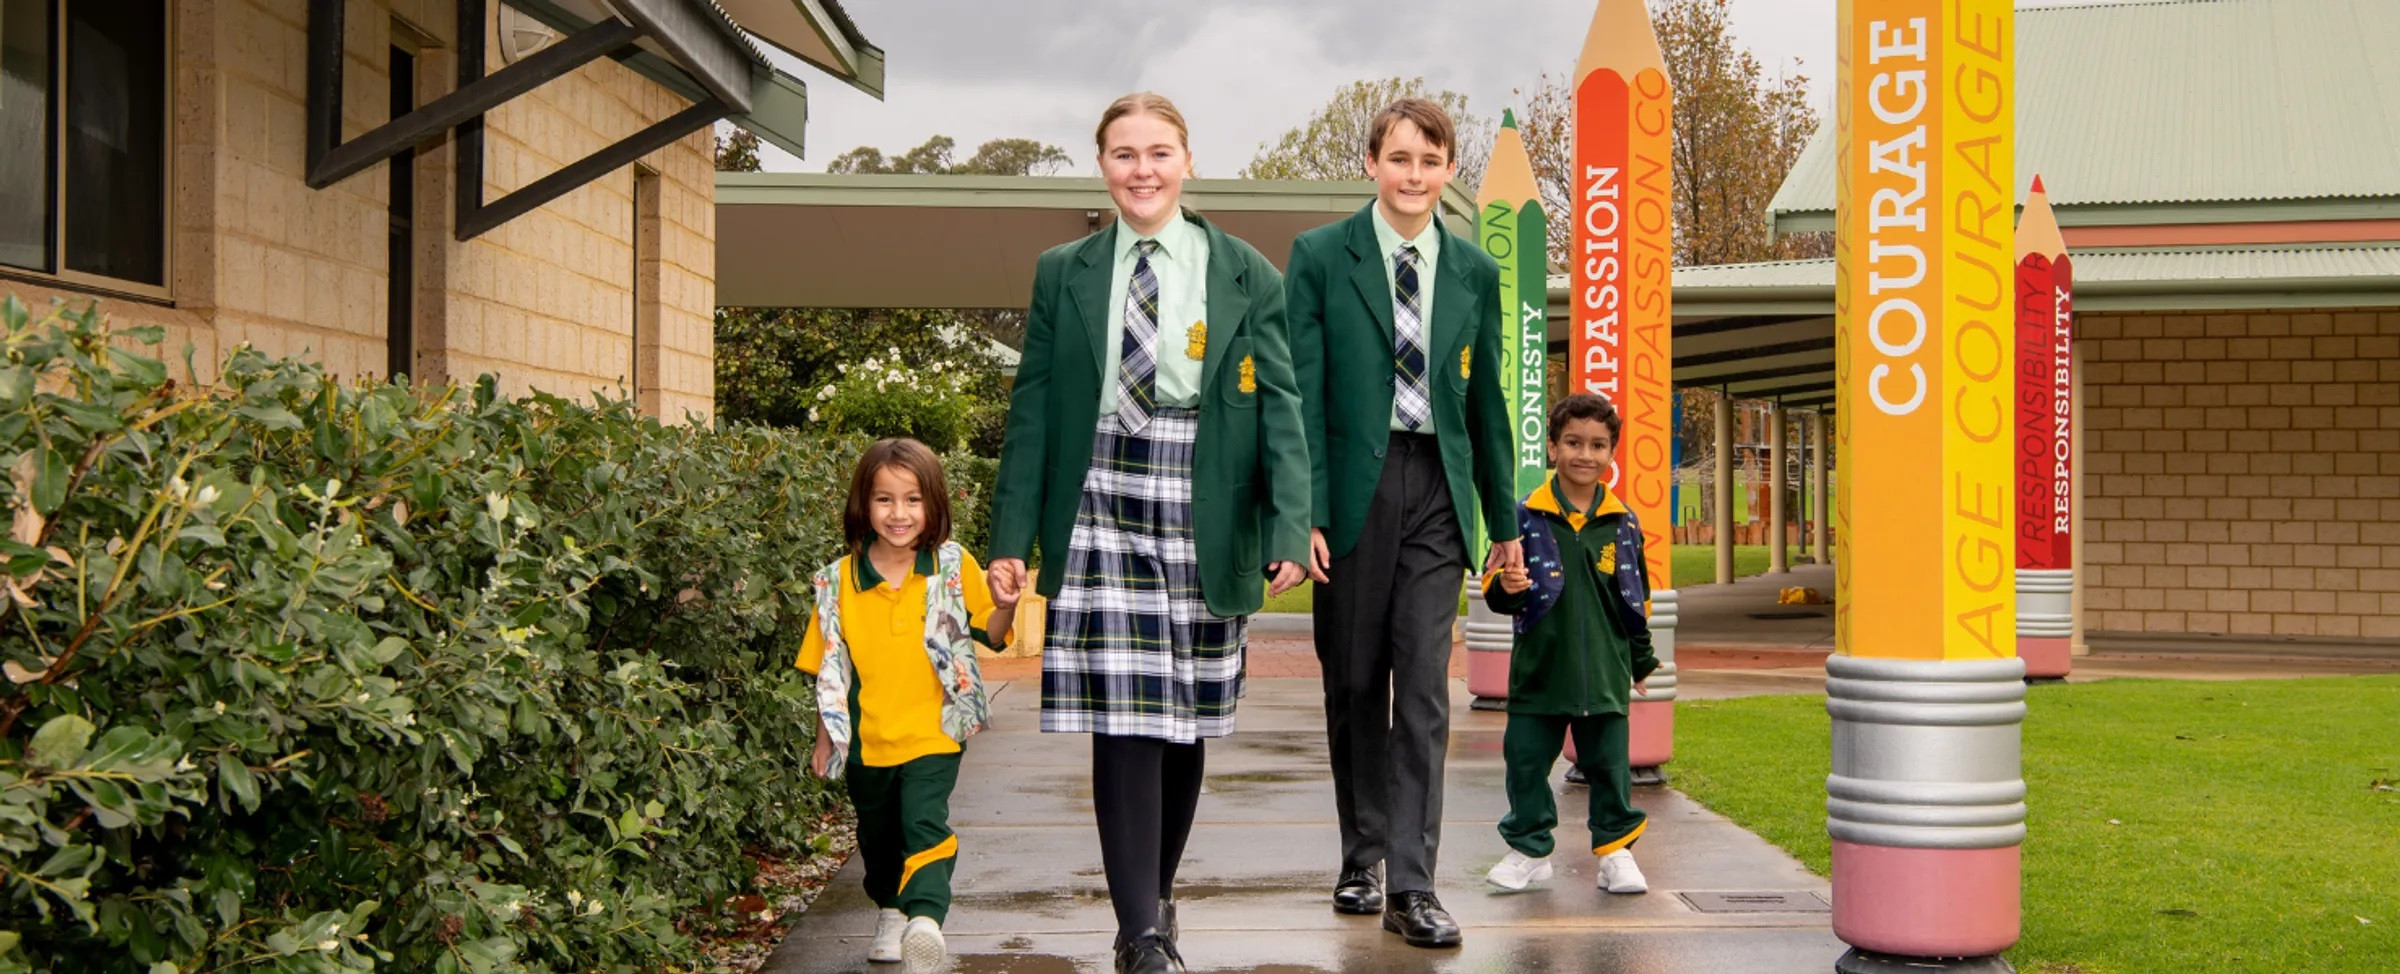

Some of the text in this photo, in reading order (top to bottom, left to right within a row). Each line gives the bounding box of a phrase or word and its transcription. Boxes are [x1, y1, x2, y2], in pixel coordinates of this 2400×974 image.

[1634, 70, 1666, 138] CO
[1869, 17, 1927, 416] COURAGE
[1522, 301, 1542, 468] HONESTY
[1586, 165, 1620, 490] MPASSION
[1633, 153, 1666, 508] COMPASSION
[1954, 0, 2005, 658] AGE COURAGE
[2022, 280, 2047, 543] RESPONSIBILITY
[2055, 285, 2070, 534] RESPONSIBILITY
